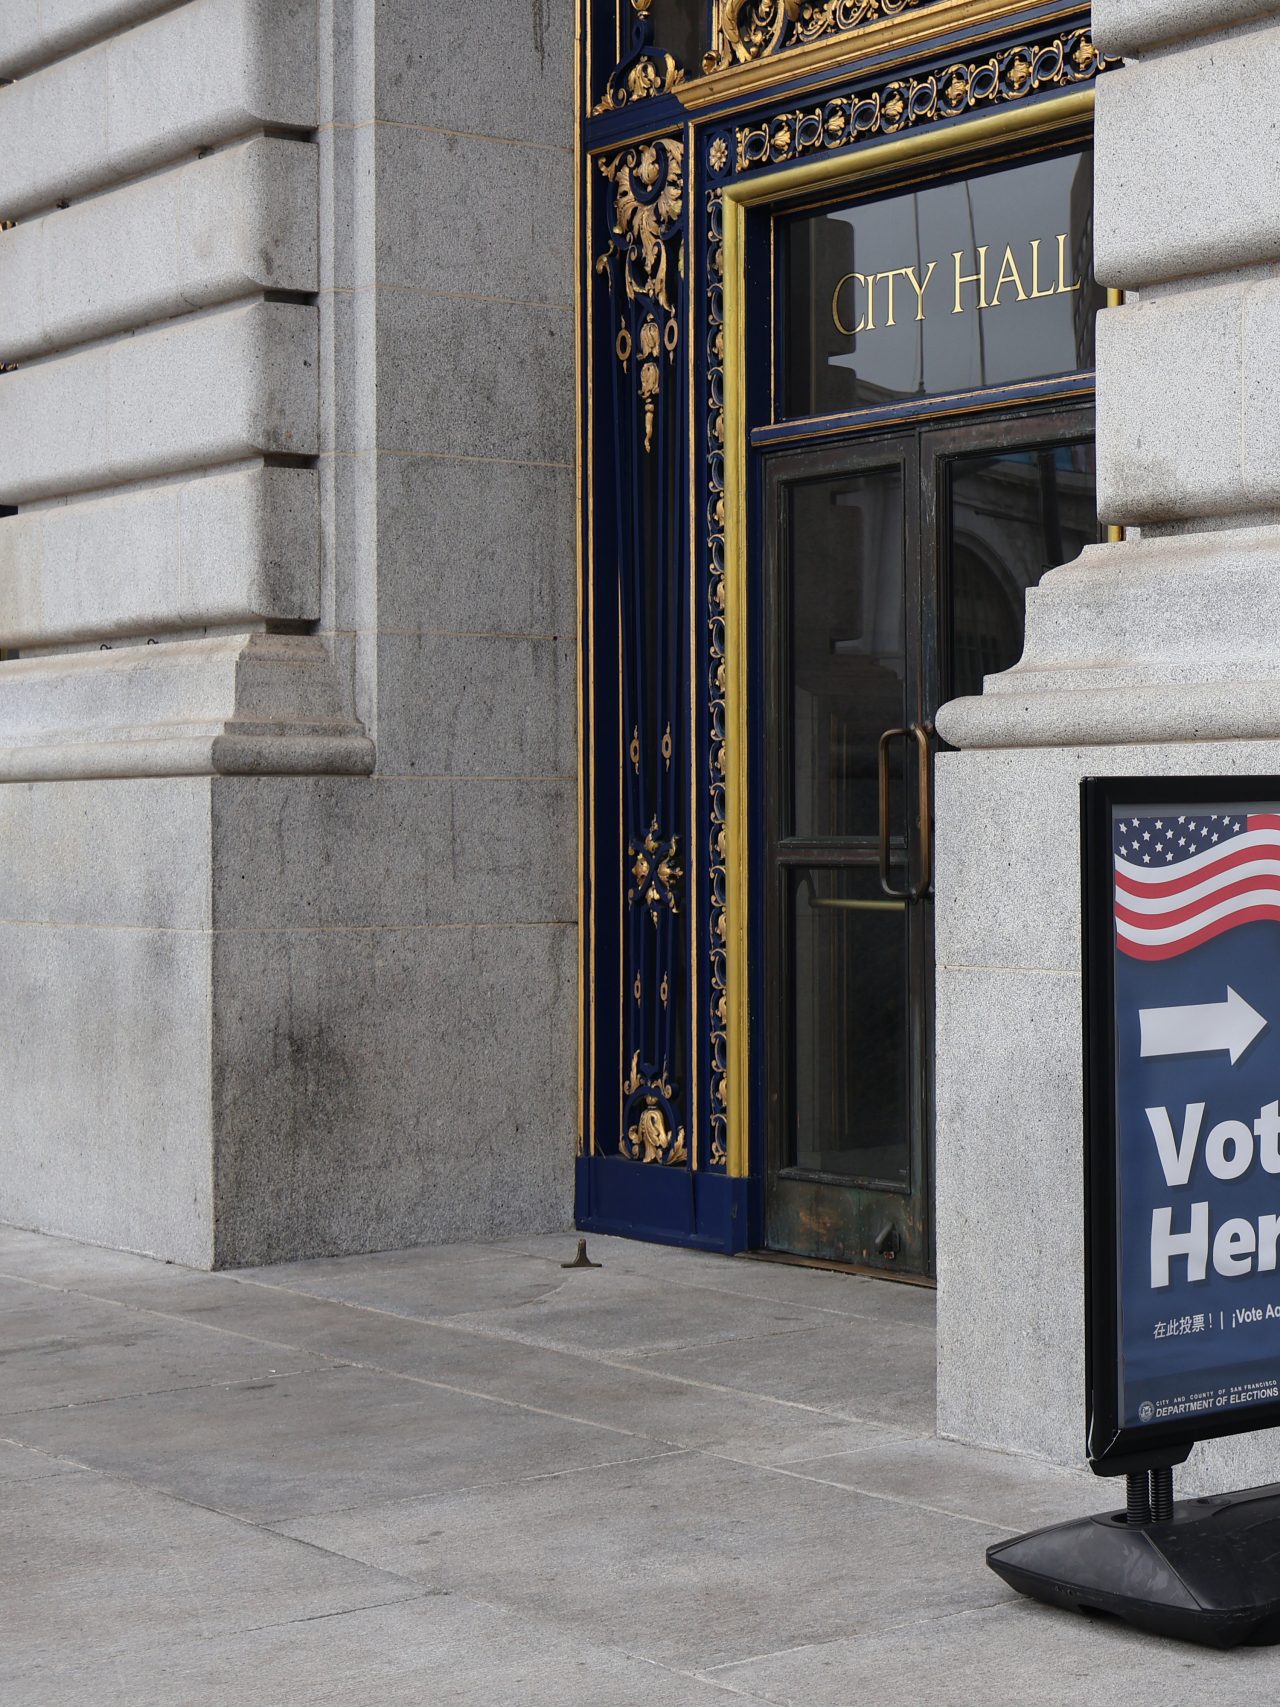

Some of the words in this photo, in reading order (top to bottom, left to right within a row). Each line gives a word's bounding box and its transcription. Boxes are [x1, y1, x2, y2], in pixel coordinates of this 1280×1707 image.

[832, 261, 937, 335] CITY
[951, 233, 1082, 314] HALL
[1232, 1307, 1263, 1328] ¡Vote
[1155, 1398, 1214, 1418] DEPARTMENT
[1215, 1395, 1228, 1407] OF
[1229, 1387, 1279, 1404] ELECTIONS
[1156, 1399, 1170, 1407] CITY
[1189, 1391, 1214, 1400] COUNTY
[1230, 1385, 1242, 1393] SAN
[1244, 1380, 1277, 1390] FRANCISCO
